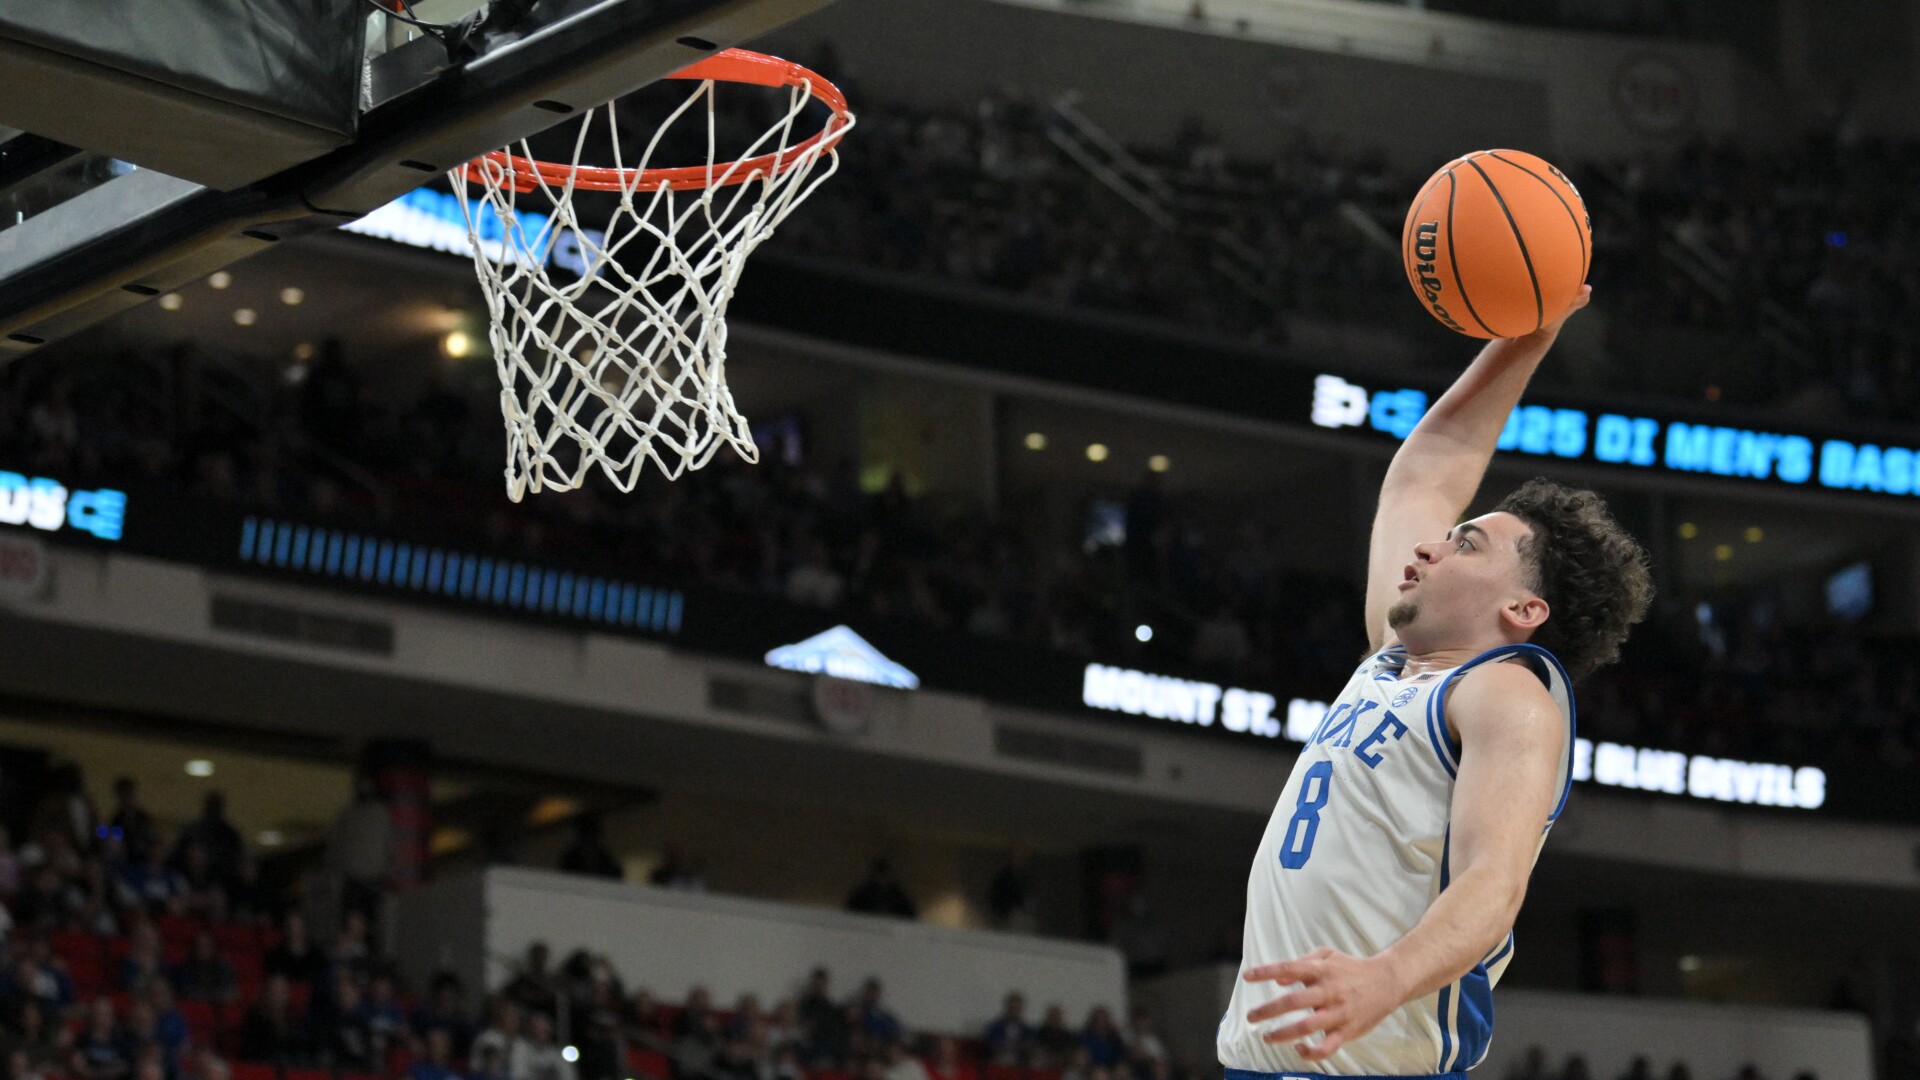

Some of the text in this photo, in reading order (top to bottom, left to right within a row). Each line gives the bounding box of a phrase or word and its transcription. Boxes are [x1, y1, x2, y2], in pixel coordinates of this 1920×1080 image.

[1414, 220, 1466, 332] Wilson
[1595, 414, 1659, 466] DI
[1665, 422, 1813, 483] MEN'S
[1819, 440, 1920, 497] BAS
[1083, 663, 1221, 726] MOUNT
[1221, 687, 1280, 738] ST.
[1279, 760, 1332, 869] 8
[1594, 742, 1688, 794] BLUE
[1688, 755, 1826, 809] DEVILS
